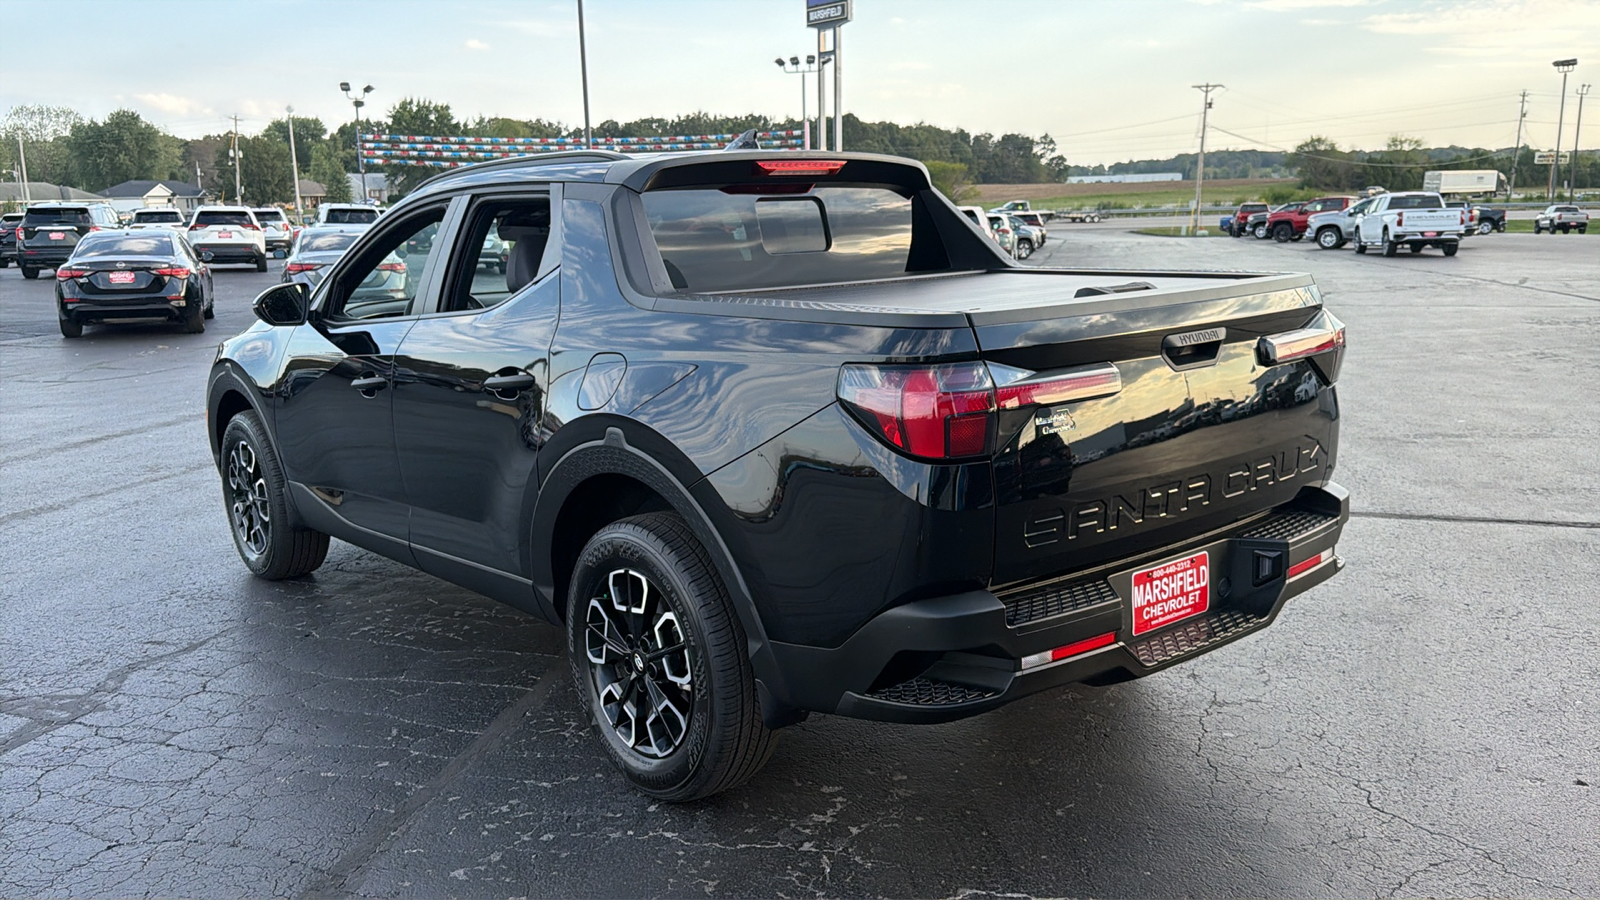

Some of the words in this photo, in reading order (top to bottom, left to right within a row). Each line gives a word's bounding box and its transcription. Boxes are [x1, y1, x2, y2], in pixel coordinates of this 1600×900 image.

[1180, 329, 1219, 346] HYUNDAI
[1023, 473, 1212, 549] SANTA
[1221, 434, 1328, 498] CRUZ
[1152, 560, 1191, 578] 800-440-2312
[1134, 565, 1208, 608] MARSHFIELD
[1142, 590, 1201, 620] CHEVROLET
